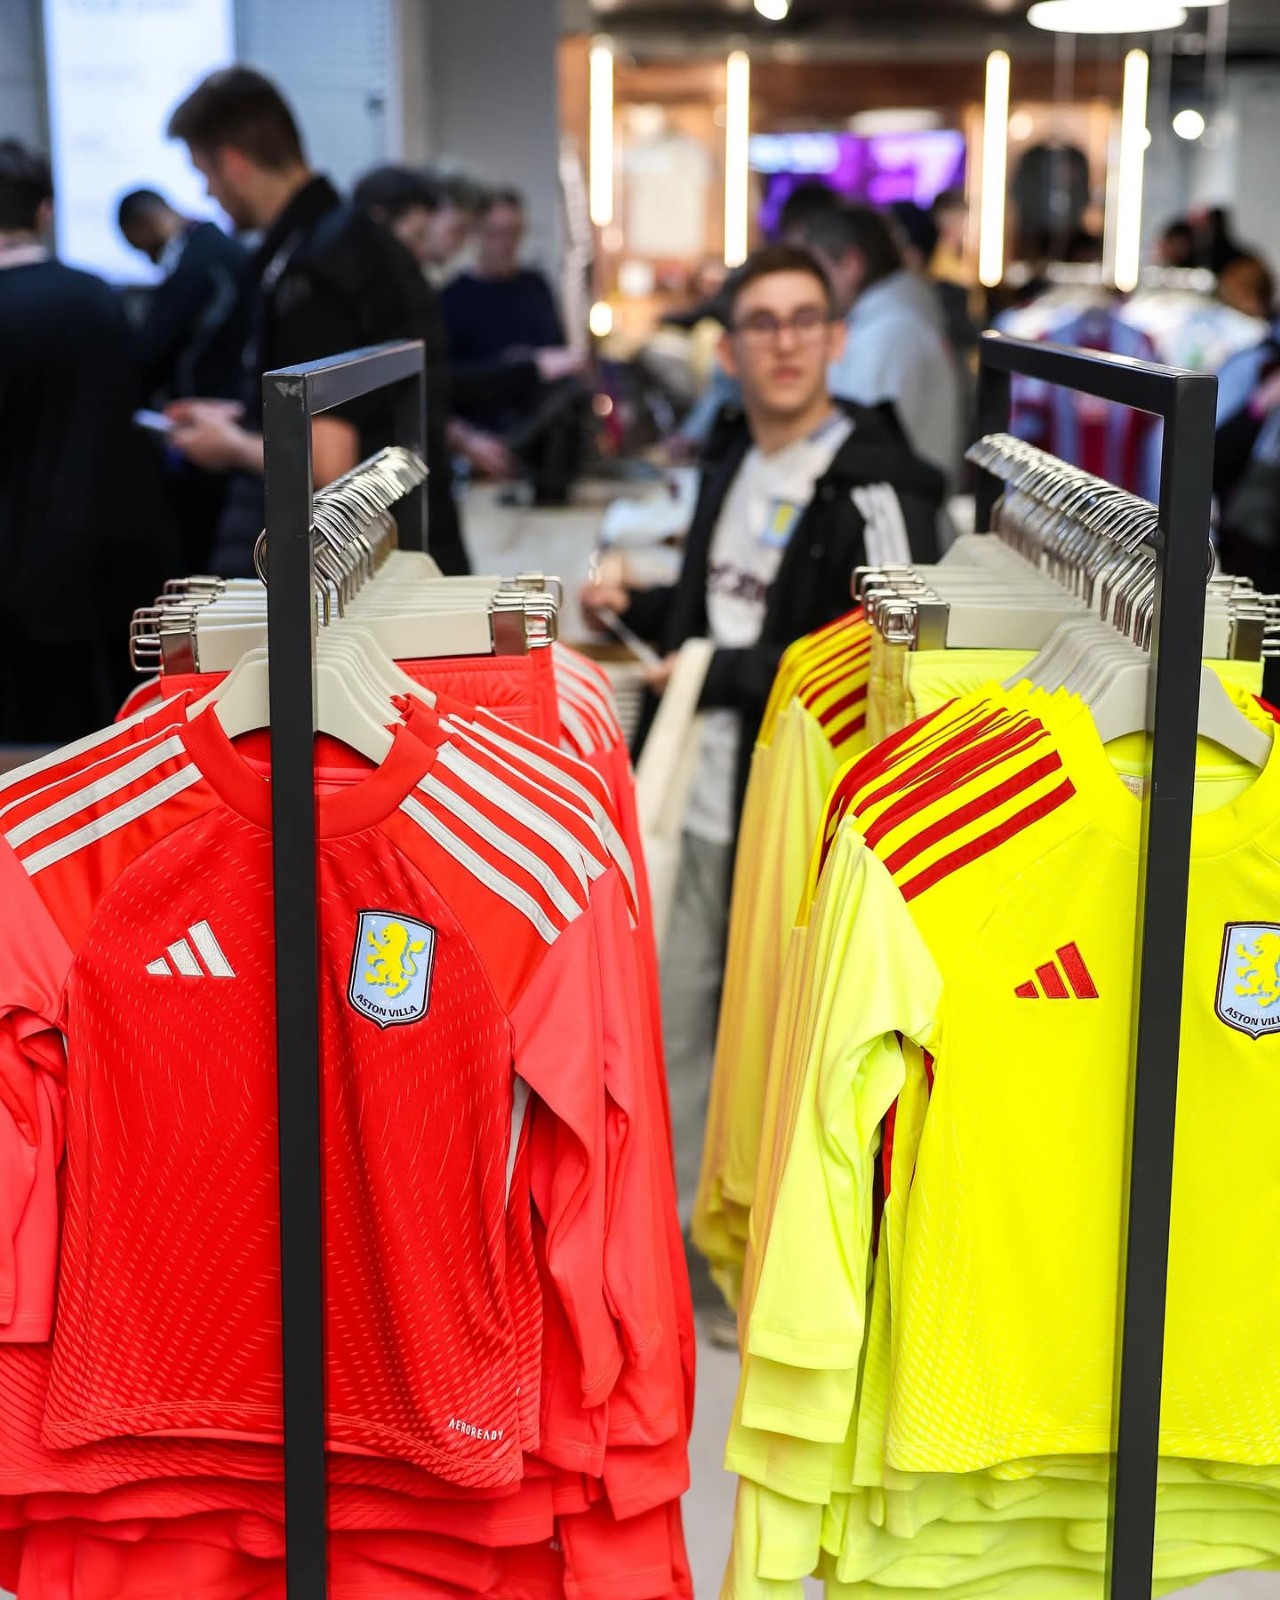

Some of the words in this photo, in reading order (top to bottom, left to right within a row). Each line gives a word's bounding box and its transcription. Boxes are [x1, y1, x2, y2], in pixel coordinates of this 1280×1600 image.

[356, 994, 386, 1016] ASTON
[389, 1005, 418, 1017] VILLA
[1225, 1007, 1258, 1025] ASTON
[1261, 1016, 1280, 1026] VILL
[448, 1418, 504, 1440] AEROREADY
